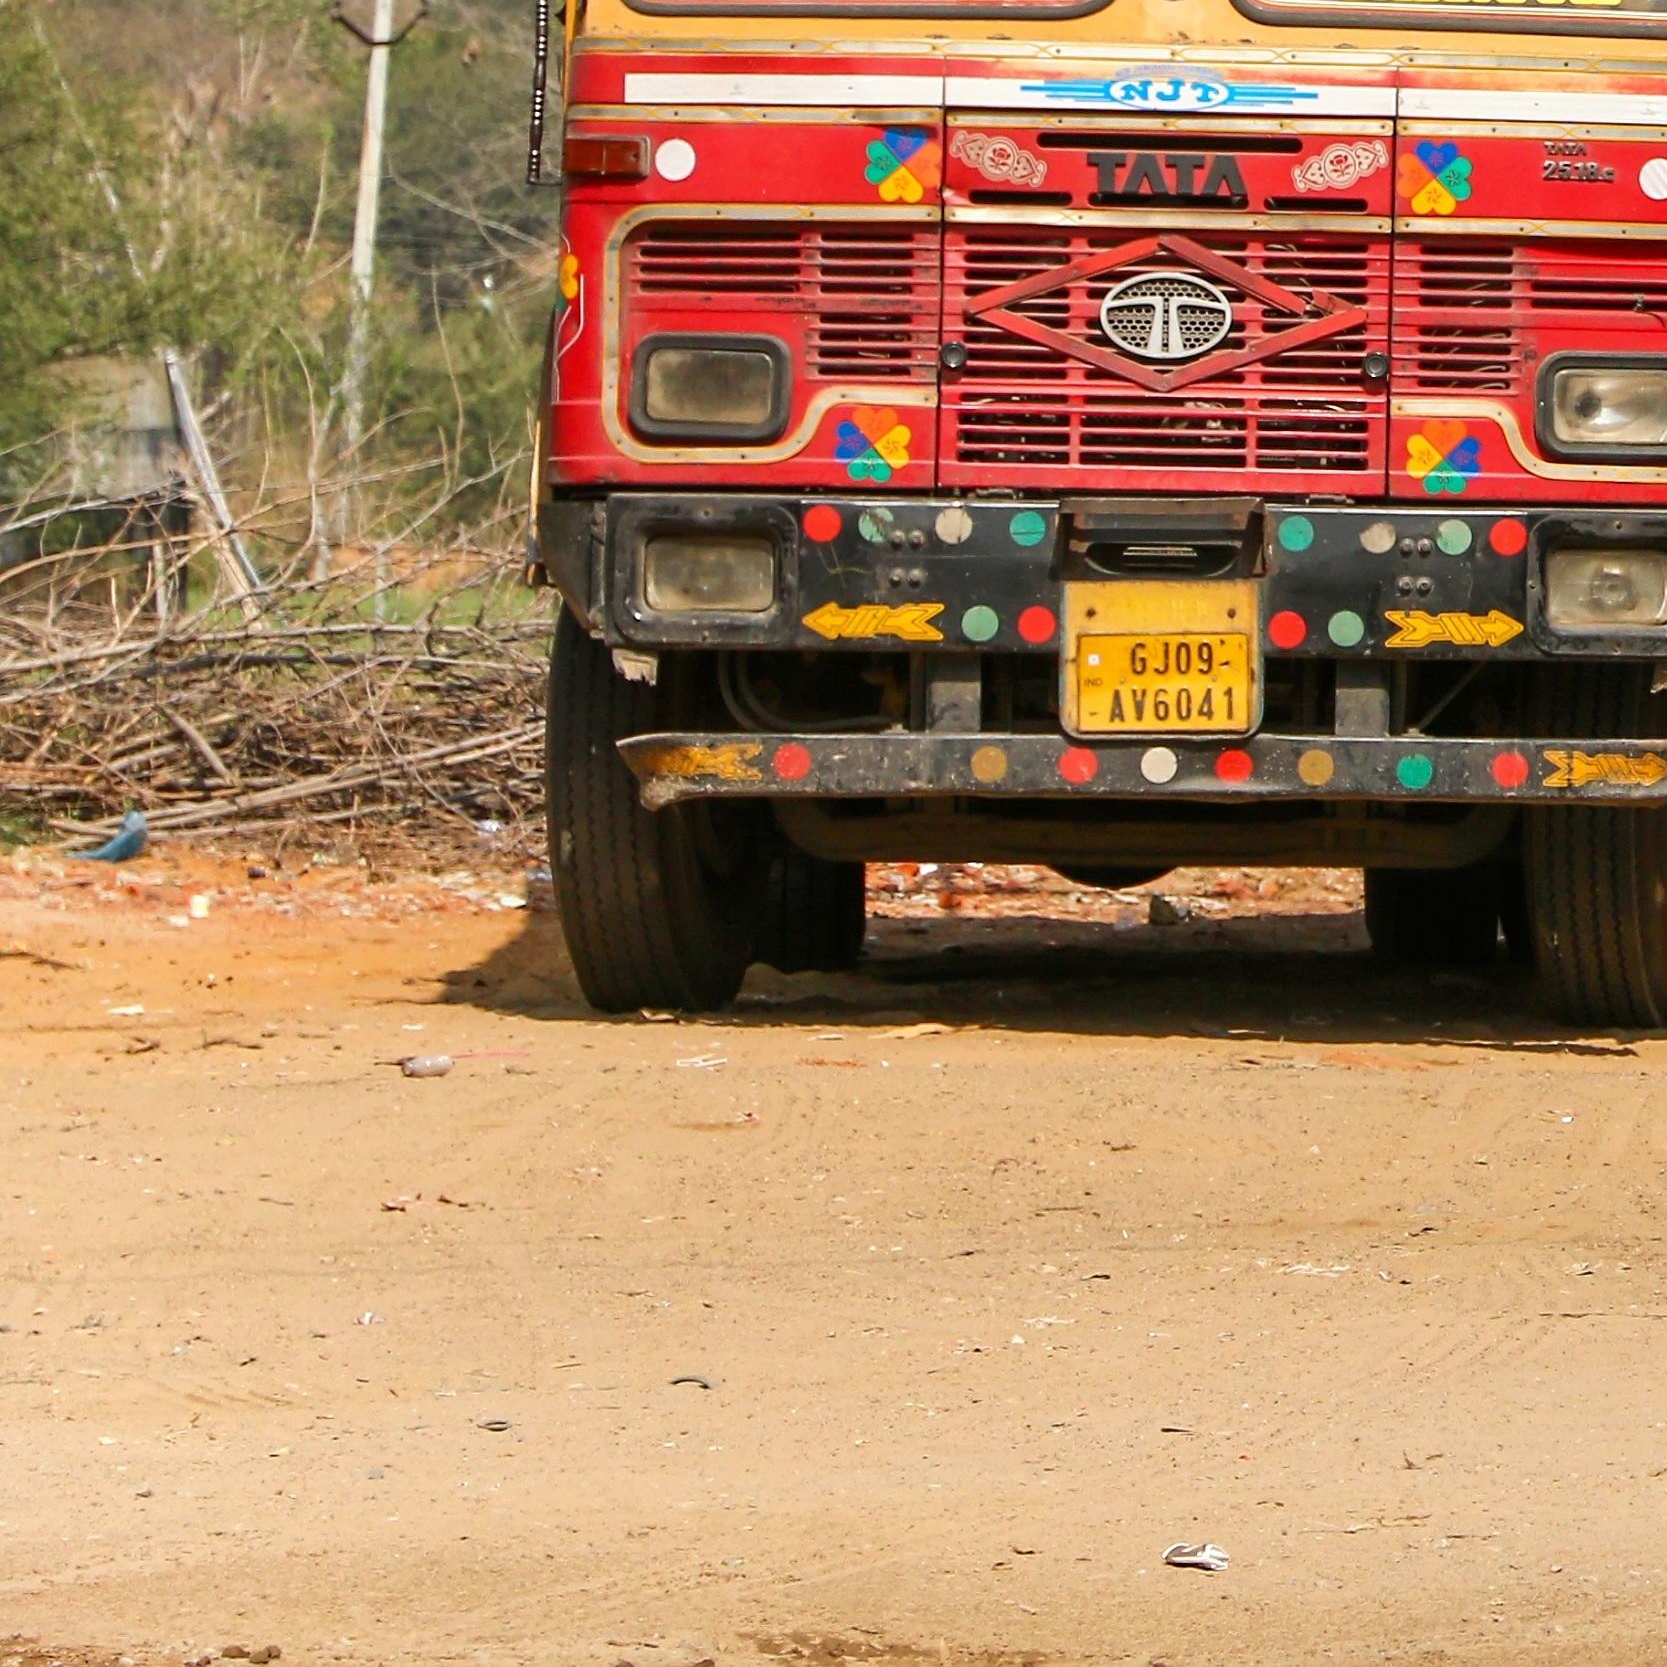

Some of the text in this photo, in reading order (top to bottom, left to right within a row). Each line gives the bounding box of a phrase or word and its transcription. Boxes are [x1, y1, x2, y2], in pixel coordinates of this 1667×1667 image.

[1121, 79, 1219, 102] NJT
[1544, 141, 1587, 156] TATA
[1087, 153, 1248, 197] TATA
[1130, 642, 1213, 675] GJ09
[1109, 687, 1235, 723] AV6041
